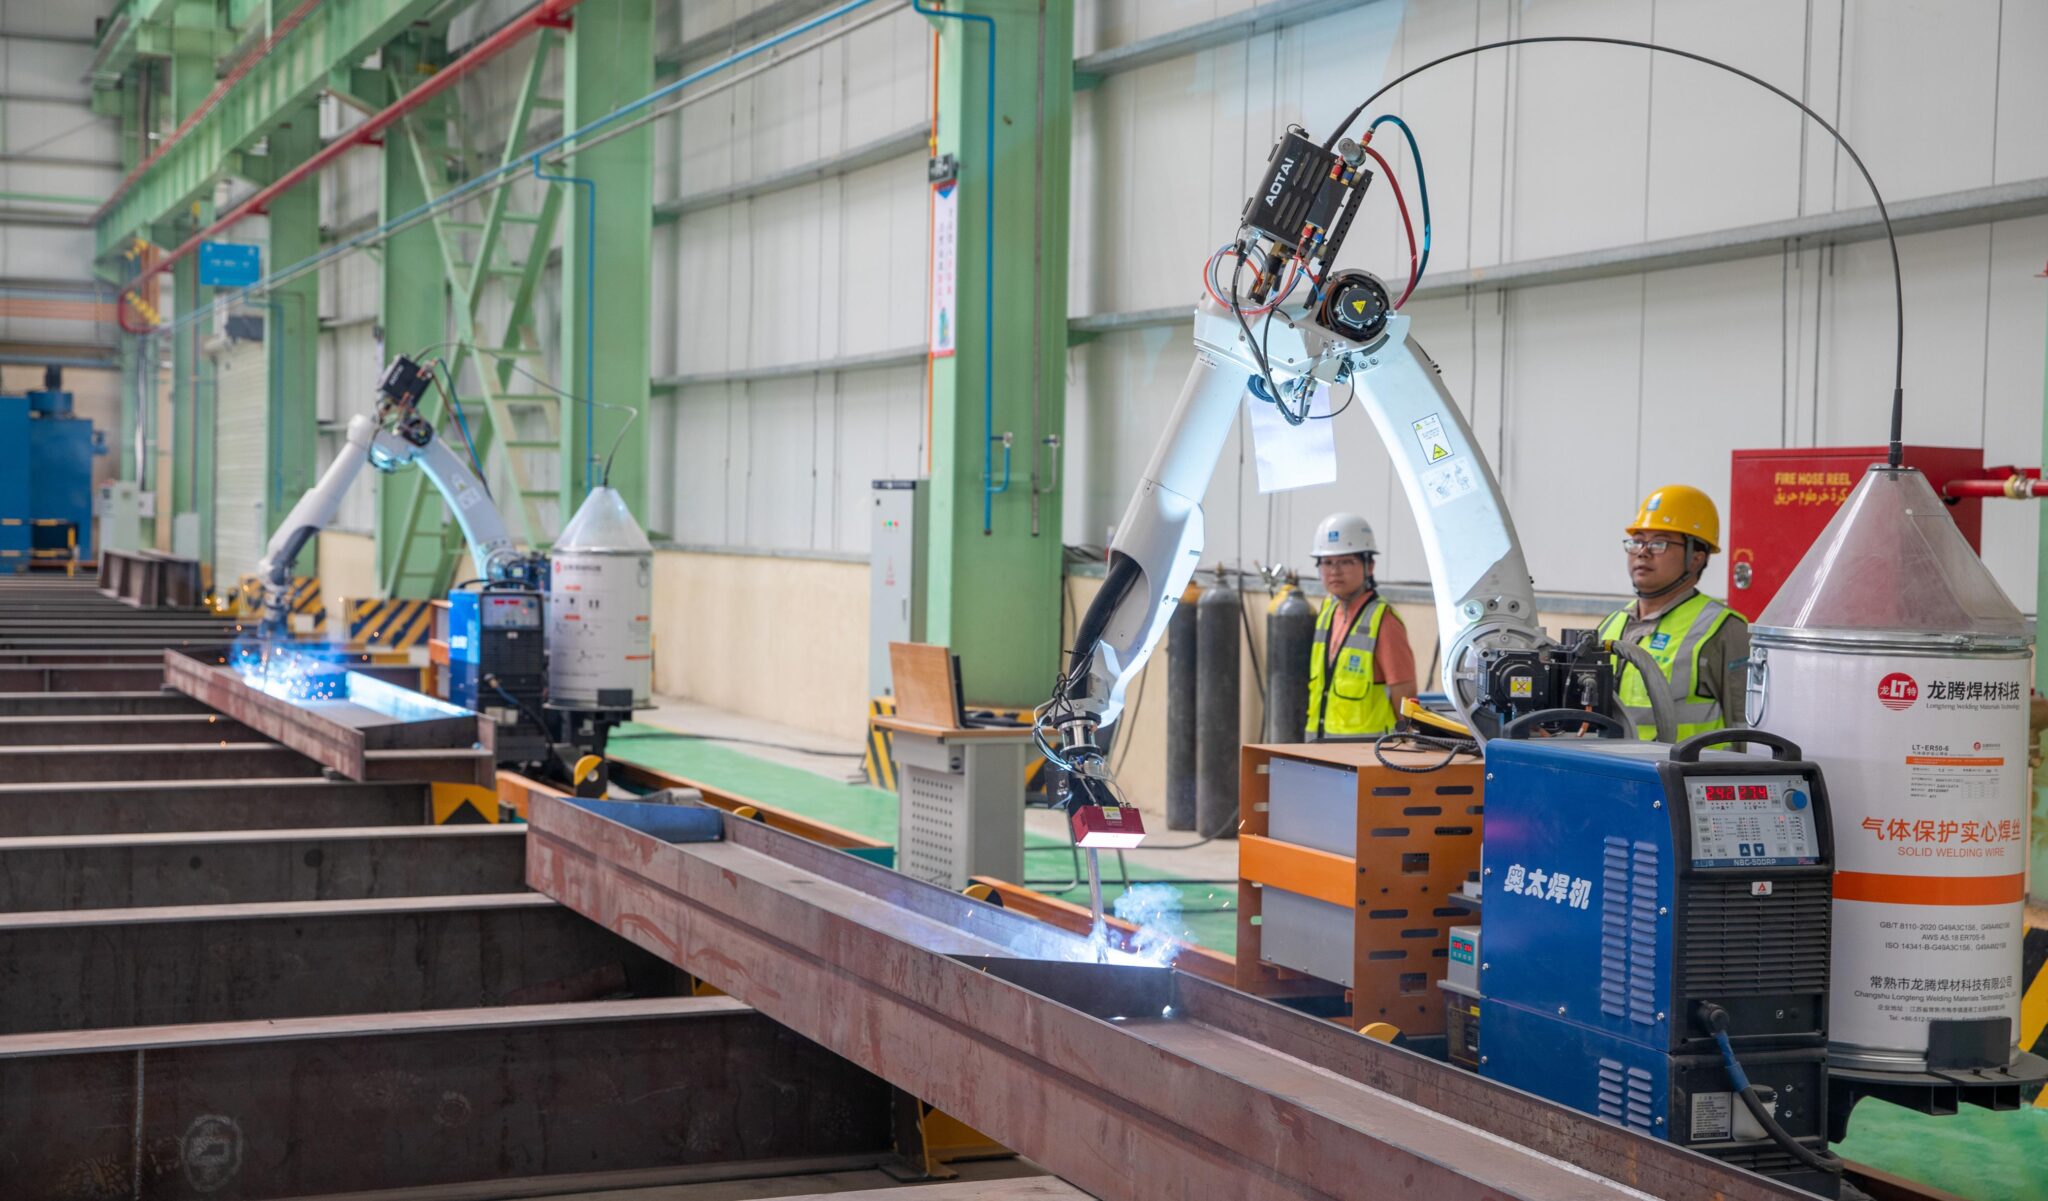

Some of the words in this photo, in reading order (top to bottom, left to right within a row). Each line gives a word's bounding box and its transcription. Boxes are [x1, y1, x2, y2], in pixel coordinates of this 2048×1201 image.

[1265, 157, 1294, 207] AOTAI
[1774, 472, 1796, 485] FIRE
[1798, 472, 1825, 485] HOSE
[1826, 472, 1852, 485] REEL
[1830, 486, 1849, 506] كرة
[1890, 679, 1909, 698] LT
[1927, 680, 2020, 701] 龙腾焊材科技
[1956, 703, 1979, 712] Welding
[1706, 786, 1735, 800] 242
[1861, 816, 2021, 843] 气体保护实心焊丝
[1897, 847, 1933, 857] SOLID
[1936, 848, 1983, 858] WELDING
[1984, 847, 2005, 857] WIRE
[1503, 864, 1592, 910] 奥太焊机
[1879, 921, 1899, 929] GB/T
[1921, 933, 1939, 941] AWS
[1870, 975, 2013, 992] 常熟市龙腾焊材科技有限公司
[1854, 990, 1890, 1001] Changshu
[1891, 994, 1925, 1003] Longteng
[1926, 995, 1952, 1003] Welding
